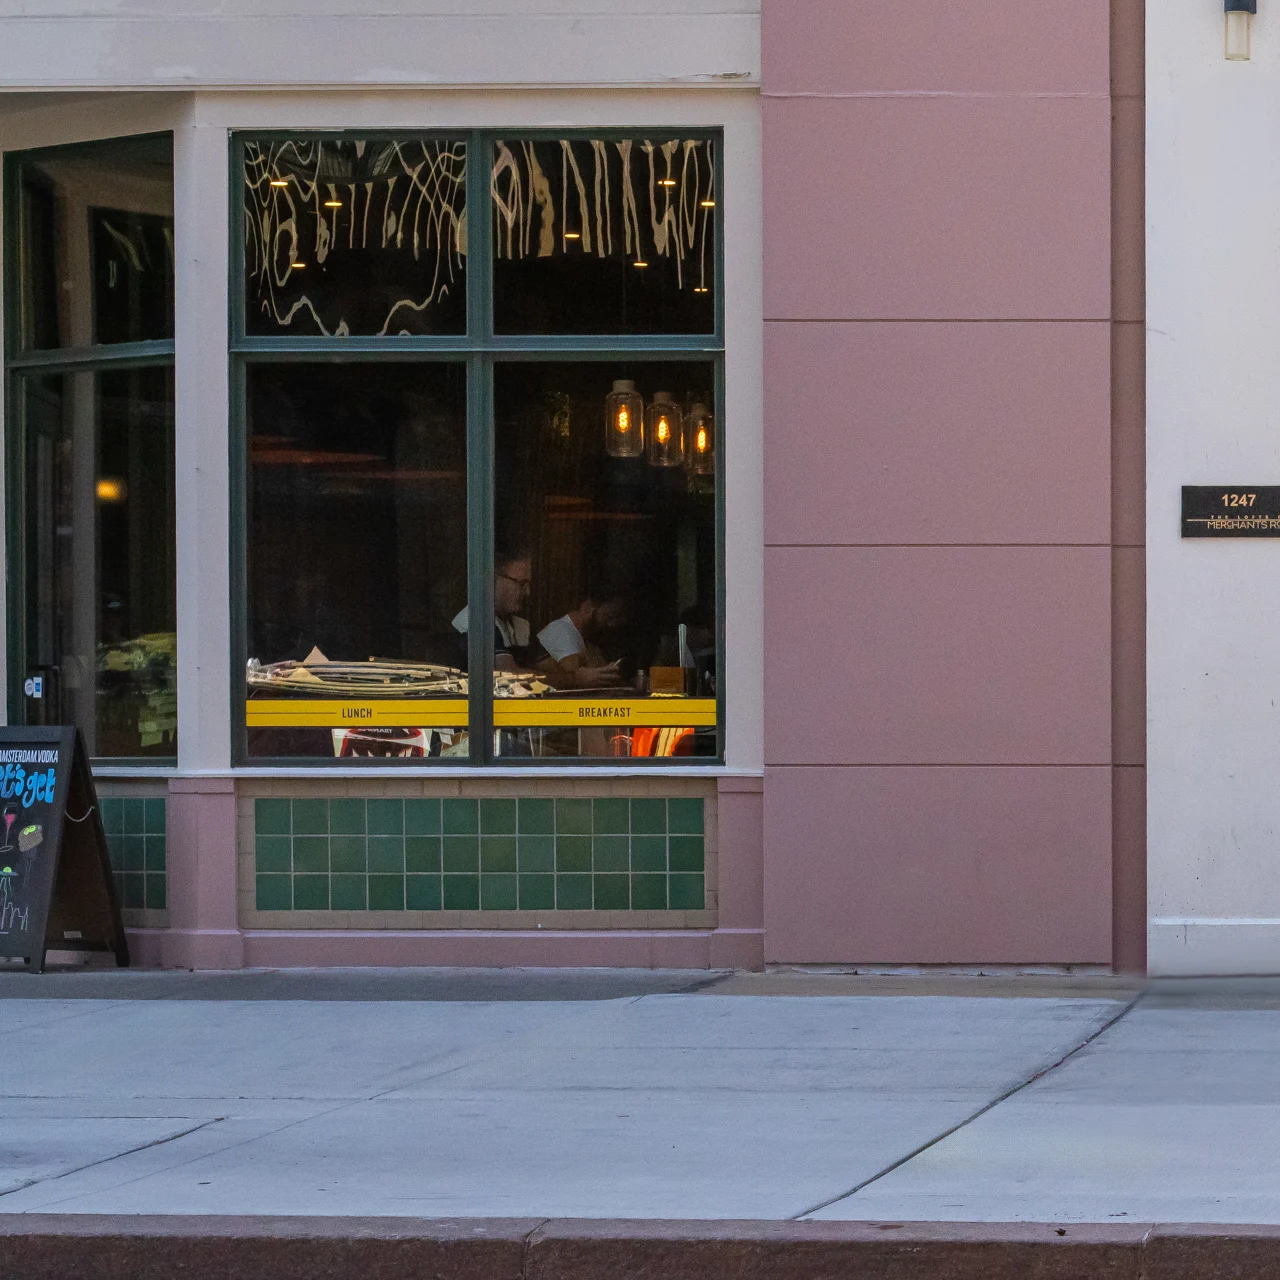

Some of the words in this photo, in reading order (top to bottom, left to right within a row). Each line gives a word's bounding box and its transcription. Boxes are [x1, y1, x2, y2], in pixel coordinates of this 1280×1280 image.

[1221, 493, 1257, 507] 1247
[1207, 520, 1268, 530] MERCHANTS
[341, 707, 373, 718] LUNCH
[578, 707, 631, 718] BREAKFAST
[0, 749, 37, 762] AMSTERDAM
[37, 750, 59, 762] VODKA
[22, 768, 56, 808] get
